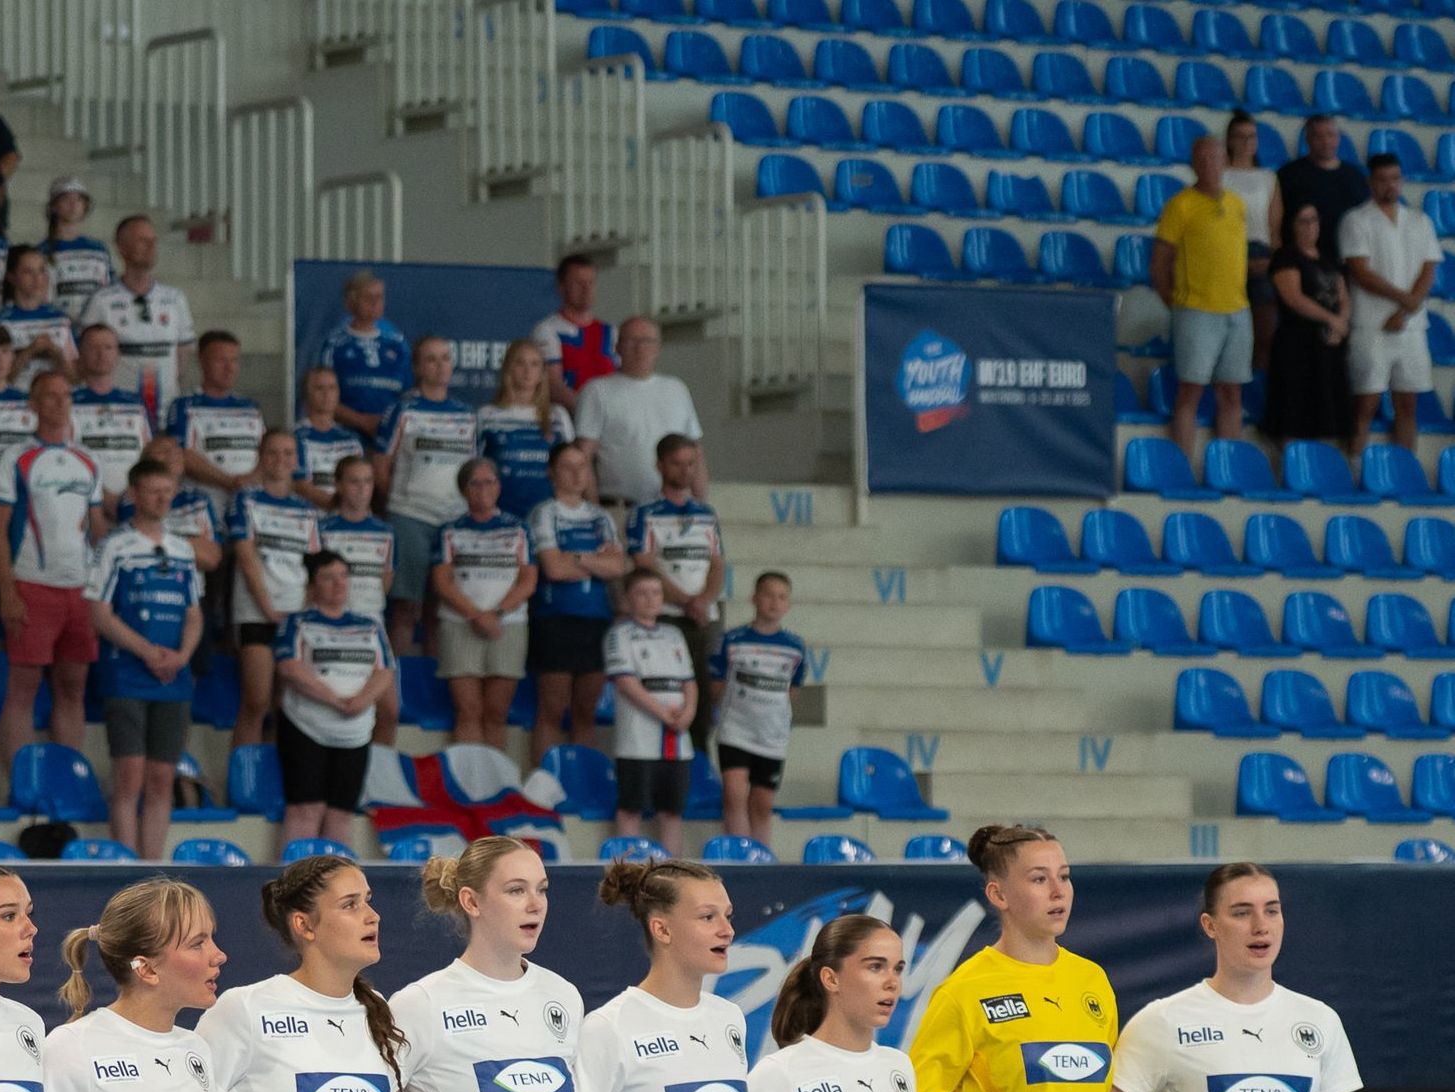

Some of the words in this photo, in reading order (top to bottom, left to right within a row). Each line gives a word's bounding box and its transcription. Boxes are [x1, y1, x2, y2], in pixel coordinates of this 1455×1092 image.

[905, 351, 967, 387] YOUTH
[1019, 360, 1045, 388] EHF
[1047, 361, 1087, 389] EURO
[770, 492, 812, 525] VII
[873, 568, 906, 603] VI
[981, 652, 1003, 688] V
[907, 734, 940, 770] IV
[1078, 736, 1113, 772] IV
[1190, 824, 1219, 858] III
[443, 1009, 487, 1032] hella
[984, 999, 1028, 1021] hella
[261, 1015, 309, 1035] hella
[1178, 1027, 1224, 1045] hella
[634, 1036, 680, 1058] hella
[94, 1059, 140, 1079] hella
[1051, 1055, 1089, 1069] TENA
[507, 1071, 553, 1086] TENA
